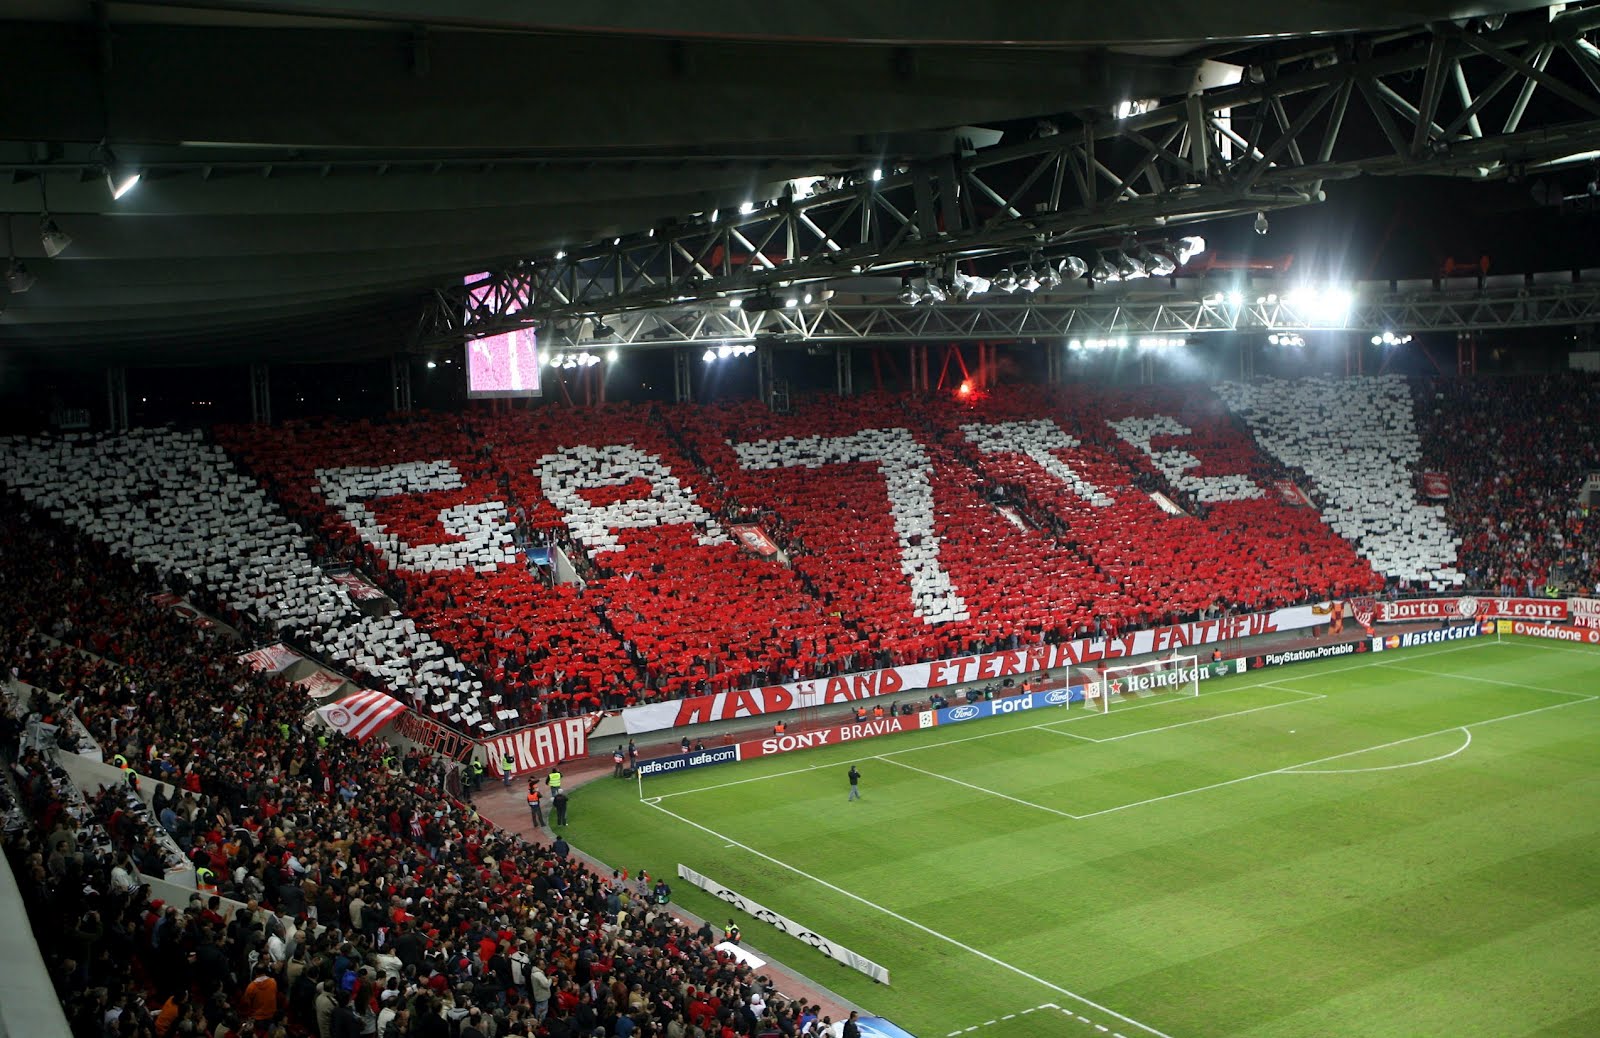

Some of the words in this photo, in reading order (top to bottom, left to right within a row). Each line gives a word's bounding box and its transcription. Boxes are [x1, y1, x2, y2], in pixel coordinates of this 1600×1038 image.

[1381, 601, 1438, 620] Porto
[1494, 600, 1562, 617] Leone
[1402, 623, 1478, 648] MasterCard
[1525, 624, 1582, 641] vodafone
[673, 685, 793, 727] MAD
[824, 668, 903, 704] AND
[928, 632, 1135, 688] ETERNALLY
[1152, 612, 1278, 652] FAITHFUL
[1127, 666, 1210, 692] Heineken
[991, 693, 1033, 715] Ford
[762, 730, 832, 755] SONY
[840, 718, 902, 741] BRAVIA
